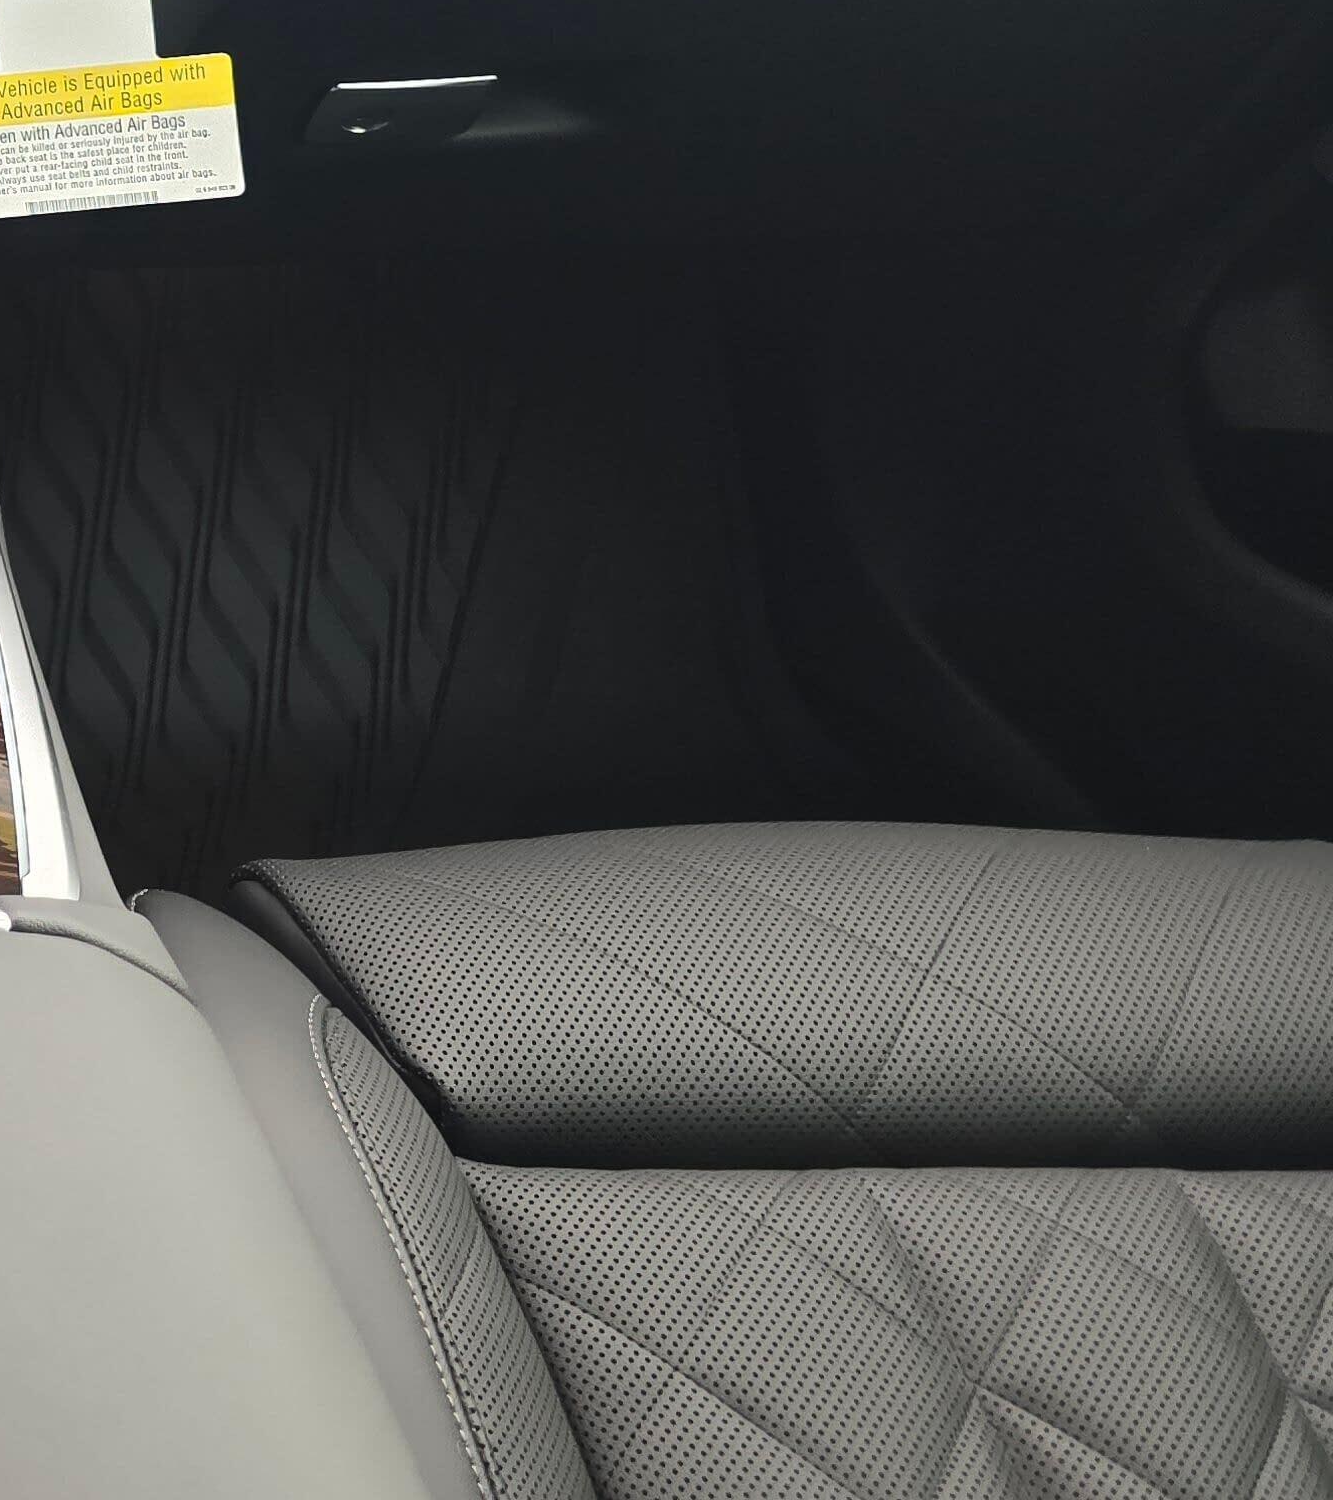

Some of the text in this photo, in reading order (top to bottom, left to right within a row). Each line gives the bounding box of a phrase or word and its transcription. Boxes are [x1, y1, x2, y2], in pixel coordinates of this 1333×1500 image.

[64, 76, 78, 92] is
[84, 67, 164, 91] Equipped
[169, 63, 206, 82] with
[1, 91, 163, 120] Advanced Air Bags
[20, 125, 50, 142] with
[55, 119, 123, 140] Advanced
[127, 116, 147, 133] Air
[151, 114, 186, 131] Bags
[0, 147, 16, 155] can
[18, 145, 29, 153] be
[32, 142, 56, 153] killed
[58, 141, 67, 150] or
[70, 136, 111, 148] seriously
[113, 133, 145, 146] injured
[147, 133, 157, 142] by
[160, 131, 175, 140] the
[177, 130, 188, 139] air
[191, 129, 211, 138] bag.
[5, 154, 27, 165] back
[28, 153, 47, 162] seat
[49, 152, 58, 160] is
[60, 150, 75, 159] the
[77, 147, 104, 158] safest
[106, 146, 129, 157] place
[132, 143, 145, 153] for
[148, 140, 187, 152] children.
[15, 165, 30, 175] put
[32, 165, 38, 173] a
[40, 159, 88, 172] rear-facing
[91, 156, 113, 167] child
[115, 155, 134, 165] seat
[136, 154, 145, 162] in
[147, 152, 161, 161] the
[164, 150, 189, 161] front.
[29, 174, 45, 183] use
[47, 171, 66, 181] seat
[68, 169, 91, 179] belts
[93, 166, 110, 177] and
[112, 165, 134, 175] child
[137, 161, 182, 173] restraints.
[20, 183, 52, 193] manual
[54, 180, 67, 190] for
[71, 179, 94, 189] more
[96, 174, 148, 186] information
[150, 171, 175, 182] about
[177, 170, 190, 180] air
[192, 168, 217, 179] bags.
